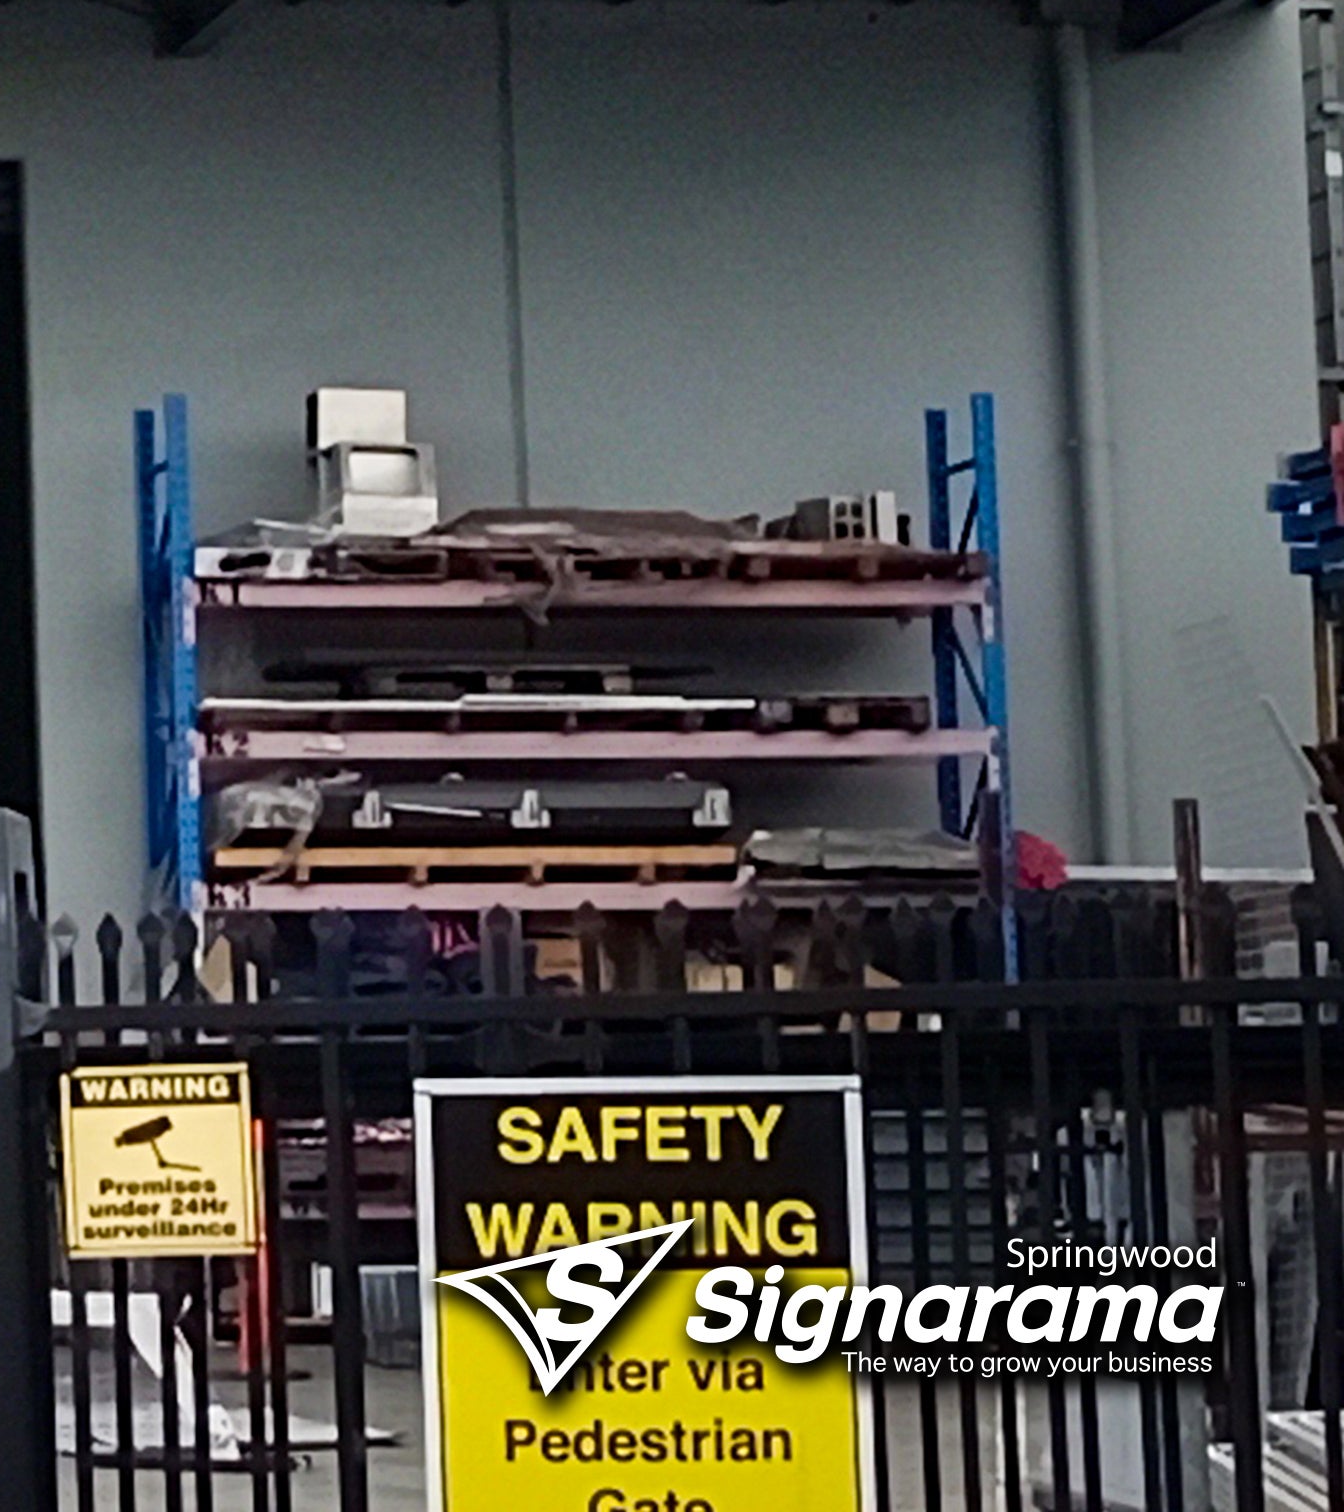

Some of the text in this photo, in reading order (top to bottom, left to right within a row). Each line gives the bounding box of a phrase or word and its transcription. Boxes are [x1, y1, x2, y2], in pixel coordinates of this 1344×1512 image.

[80, 1074, 231, 1101] WARNING
[496, 1104, 784, 1164] SAFETY
[98, 1176, 217, 1196] Premises
[89, 1197, 229, 1218] under 24Hr
[83, 1220, 237, 1240] surveillance
[687, 1353, 766, 1392] via
[504, 1418, 793, 1463] Pedestrian
